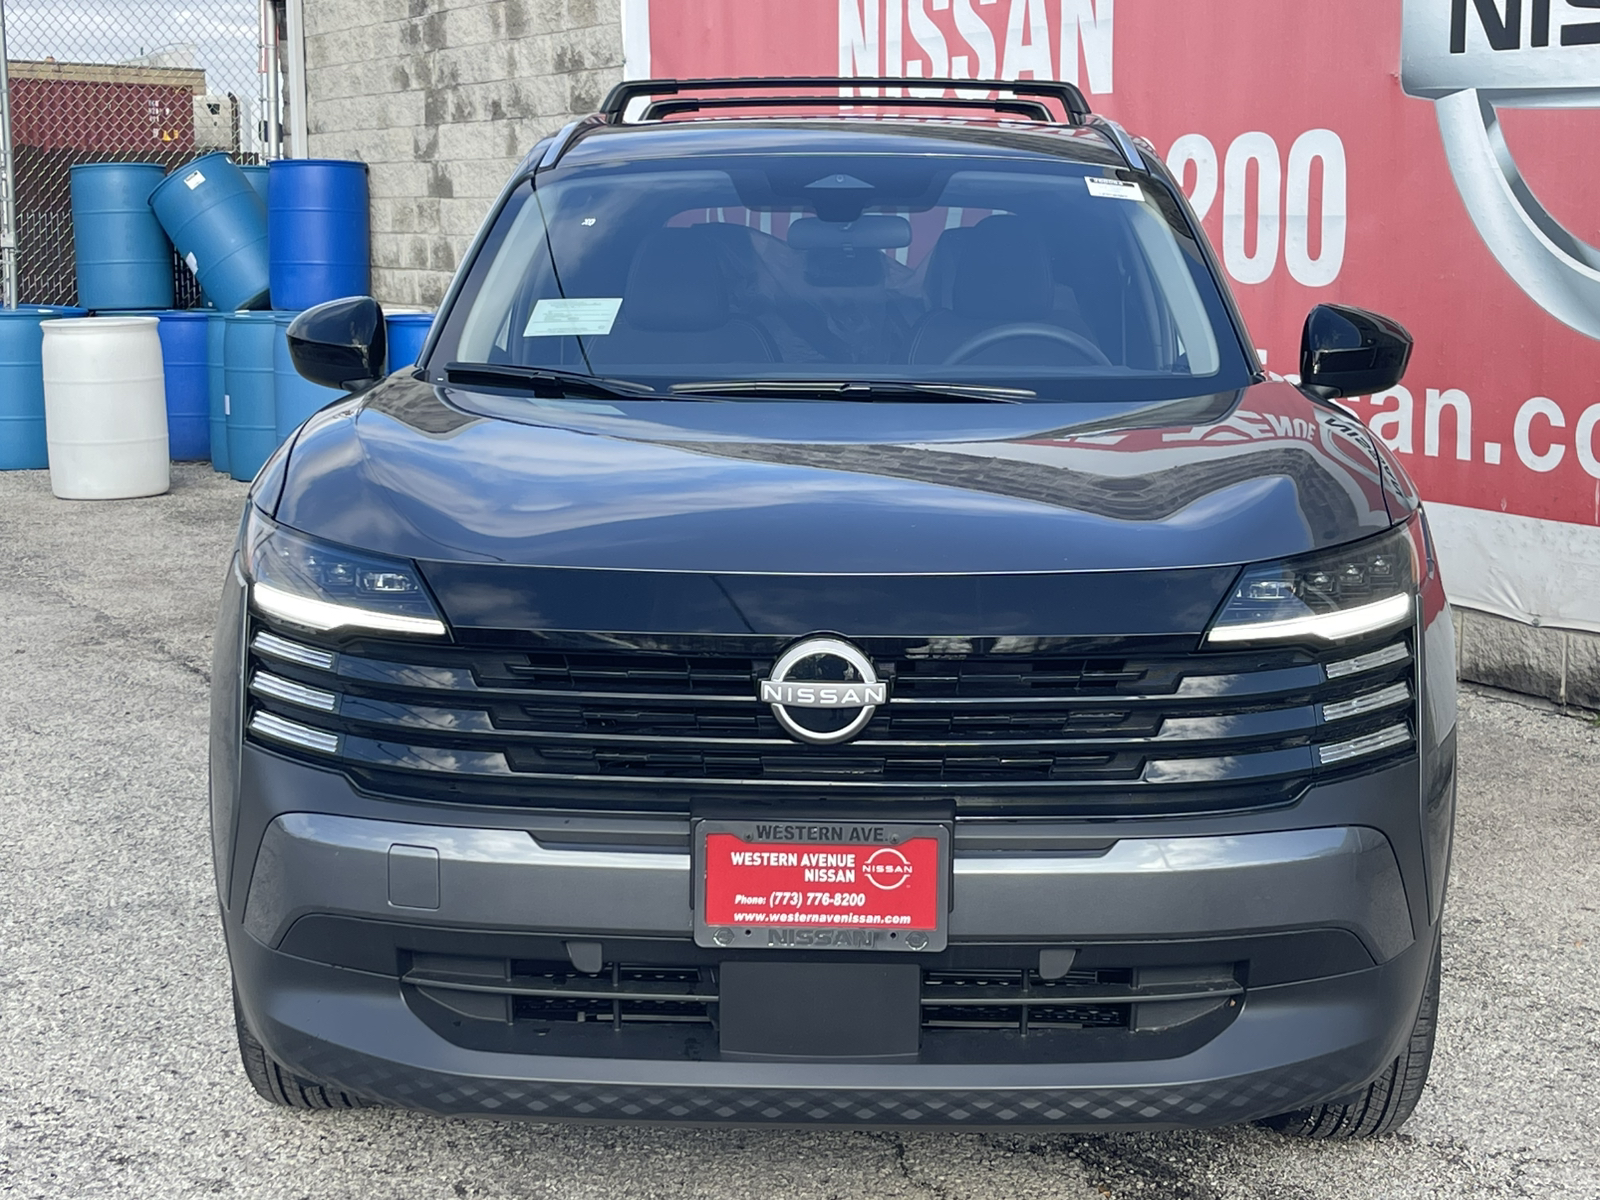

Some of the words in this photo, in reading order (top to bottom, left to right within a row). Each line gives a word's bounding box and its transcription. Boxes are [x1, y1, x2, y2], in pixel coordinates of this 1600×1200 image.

[838, 0, 1114, 109] NISSAN
[1330, 383, 1600, 480] an.c
[763, 684, 883, 704] NISSAN
[756, 825, 843, 841] WESTERN
[849, 827, 888, 842] AVE.
[730, 852, 798, 867] WESTERN
[800, 853, 856, 868] AVENUE
[804, 869, 856, 883] NISSAN
[862, 864, 913, 874] NISSAN
[734, 894, 767, 905] Phone:
[769, 892, 803, 908] (773)
[806, 892, 866, 907] 776-8200
[733, 911, 911, 925] www.westernavenissan.com
[768, 928, 876, 948] NISSAN
